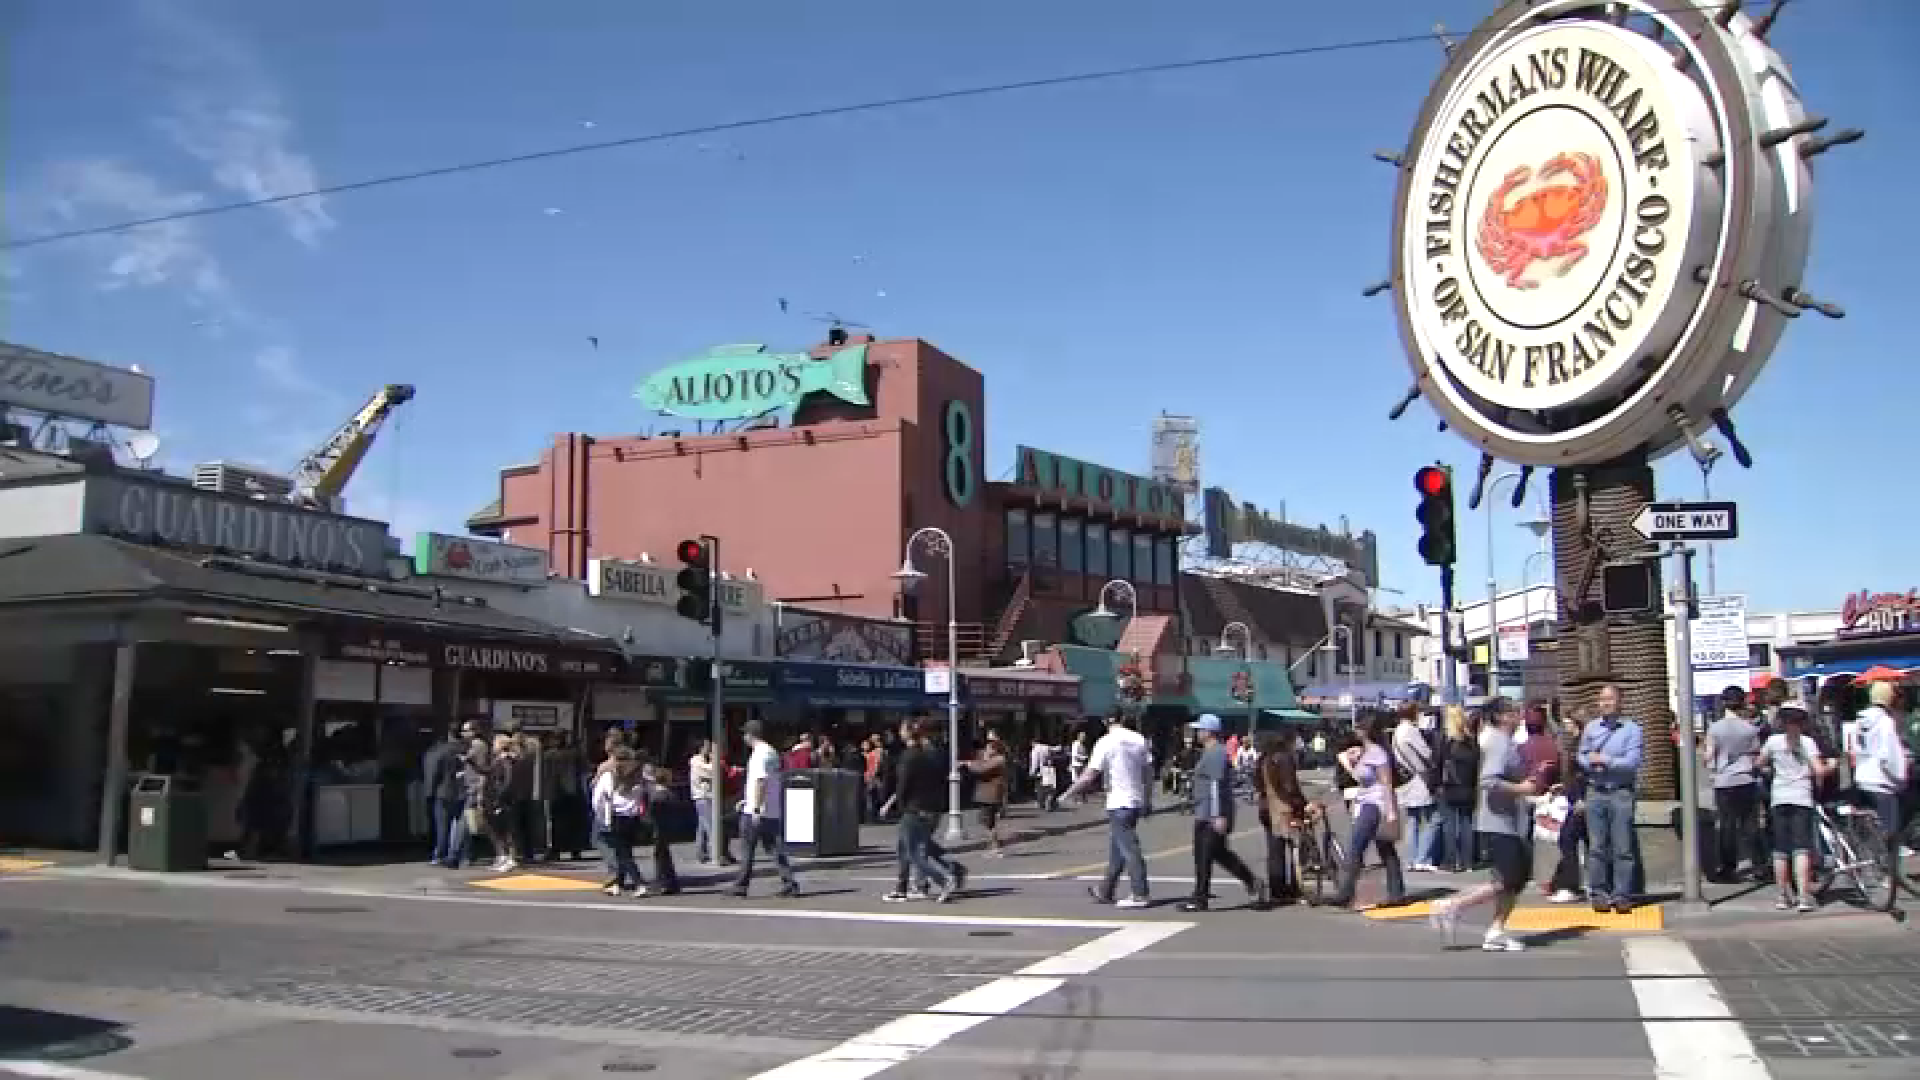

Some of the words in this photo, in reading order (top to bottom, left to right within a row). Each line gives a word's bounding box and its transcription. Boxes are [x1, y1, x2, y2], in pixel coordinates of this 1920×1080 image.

[1426, 48, 1568, 261] FISHERMANS
[1576, 48, 1669, 172] WHARF
[1433, 277, 1468, 325] OF
[1455, 319, 1515, 384] SAN
[1523, 194, 1671, 388] FRANCISCO
[662, 363, 801, 406] ALIOTO'S
[946, 400, 973, 508] 8
[120, 484, 364, 571] GUARDINO'S
[1655, 514, 1685, 529] ONE
[1691, 513, 1725, 528] WAY
[604, 567, 665, 596] SABELLA
[1868, 610, 1905, 632] HUT
[445, 645, 548, 672] GUARDINO'S
